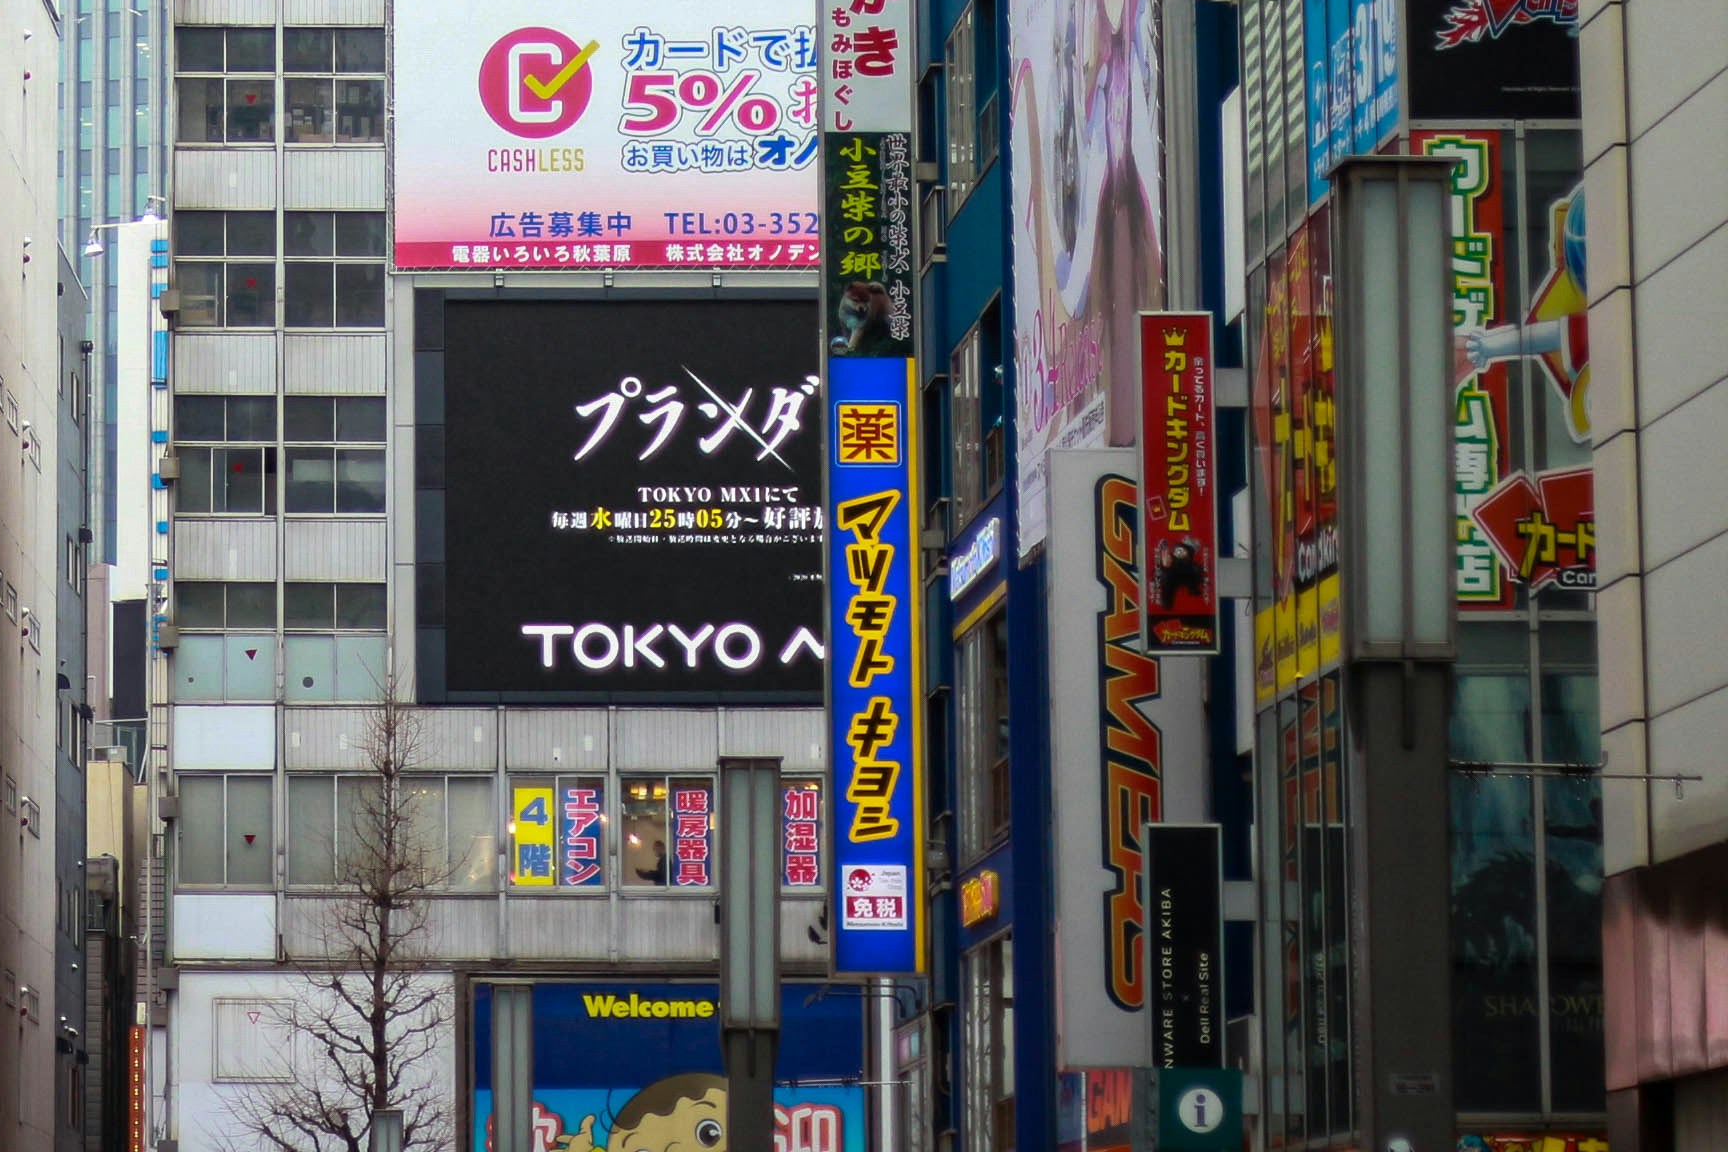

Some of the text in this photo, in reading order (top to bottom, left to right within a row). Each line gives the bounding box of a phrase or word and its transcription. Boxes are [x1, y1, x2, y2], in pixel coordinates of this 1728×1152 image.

[831, 7, 853, 131] もみほぐし
[488, 148, 585, 172] CASHLESS
[489, 211, 633, 237] 広告募集中
[839, 137, 882, 280] 小豆柴の郷
[452, 244, 632, 263] 電器いろいろ秋葉原
[841, 407, 897, 461] 薬
[1163, 349, 1190, 532] カードキングダム
[638, 486, 712, 503] TOKYO
[521, 623, 761, 669] TOKYO
[518, 796, 554, 878] 4階
[564, 788, 601, 885] エアコン
[674, 789, 710, 886] 暖房器具
[784, 789, 819, 886] 加湿器
[853, 897, 897, 918] 免税
[1160, 888, 1172, 939] AKIBA
[1161, 948, 1173, 1000] STORE
[1198, 952, 1210, 1045] Dell Real Site
[582, 993, 714, 1020] Welcome
